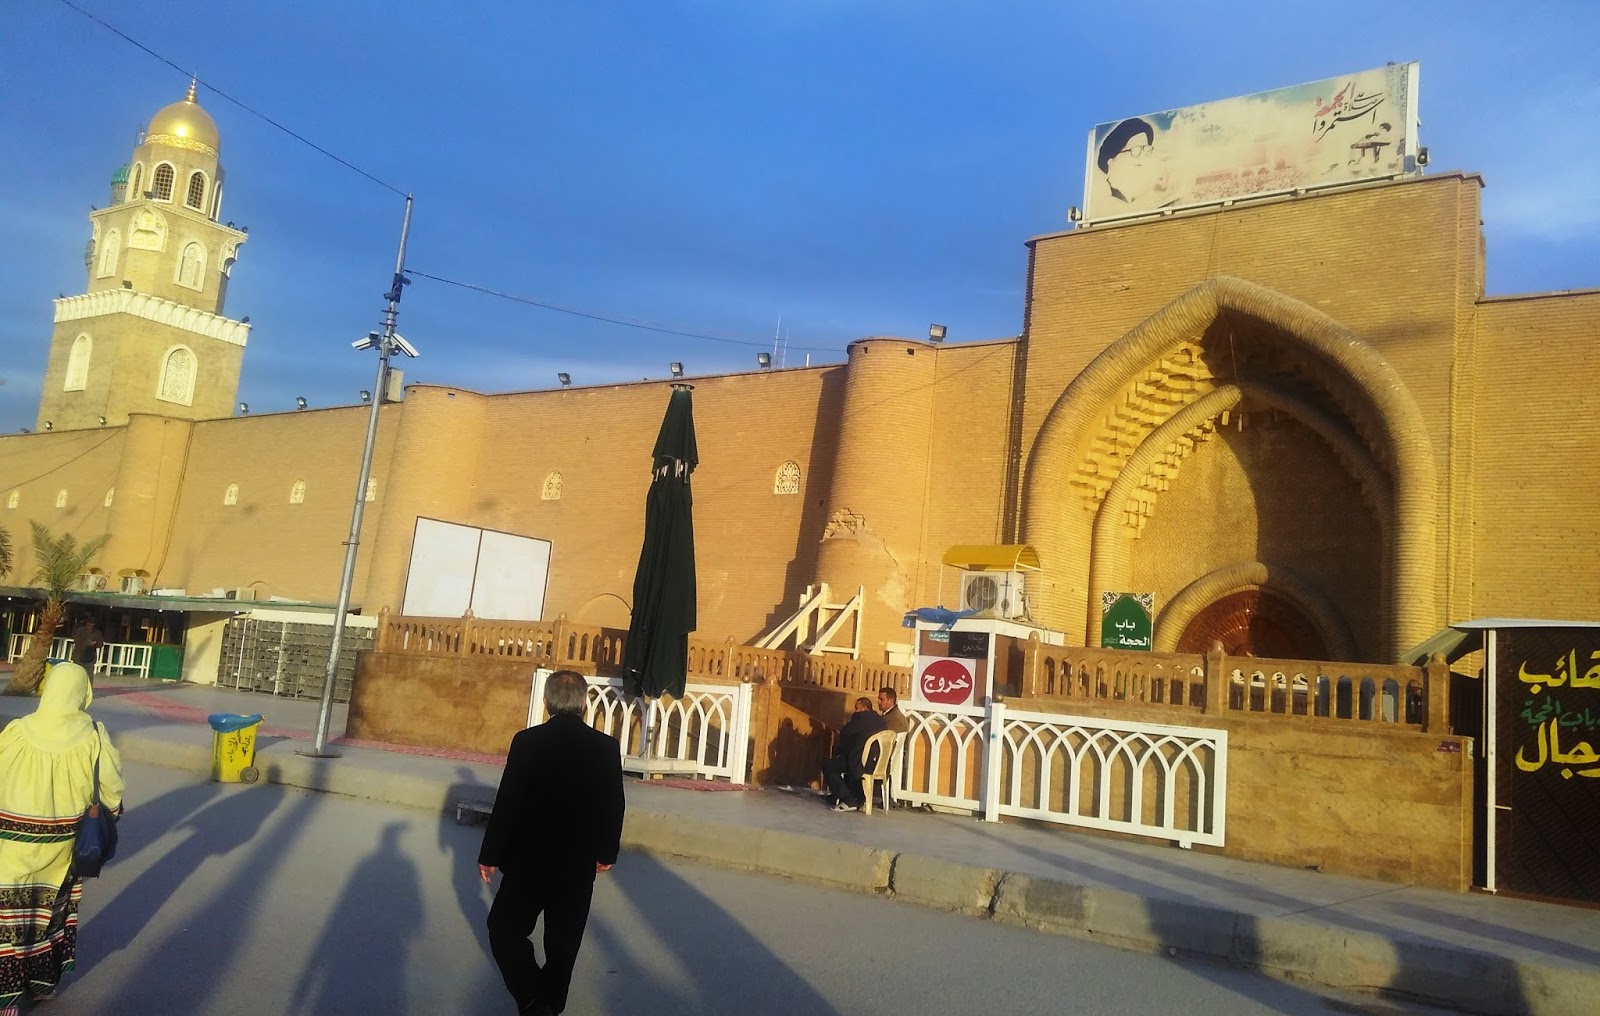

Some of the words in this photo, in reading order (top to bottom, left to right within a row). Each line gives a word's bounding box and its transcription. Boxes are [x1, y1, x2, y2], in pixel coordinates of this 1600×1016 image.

[1115, 619, 1136, 631] باب
[1119, 634, 1150, 648] الحجة
[923, 674, 970, 694] خروج
